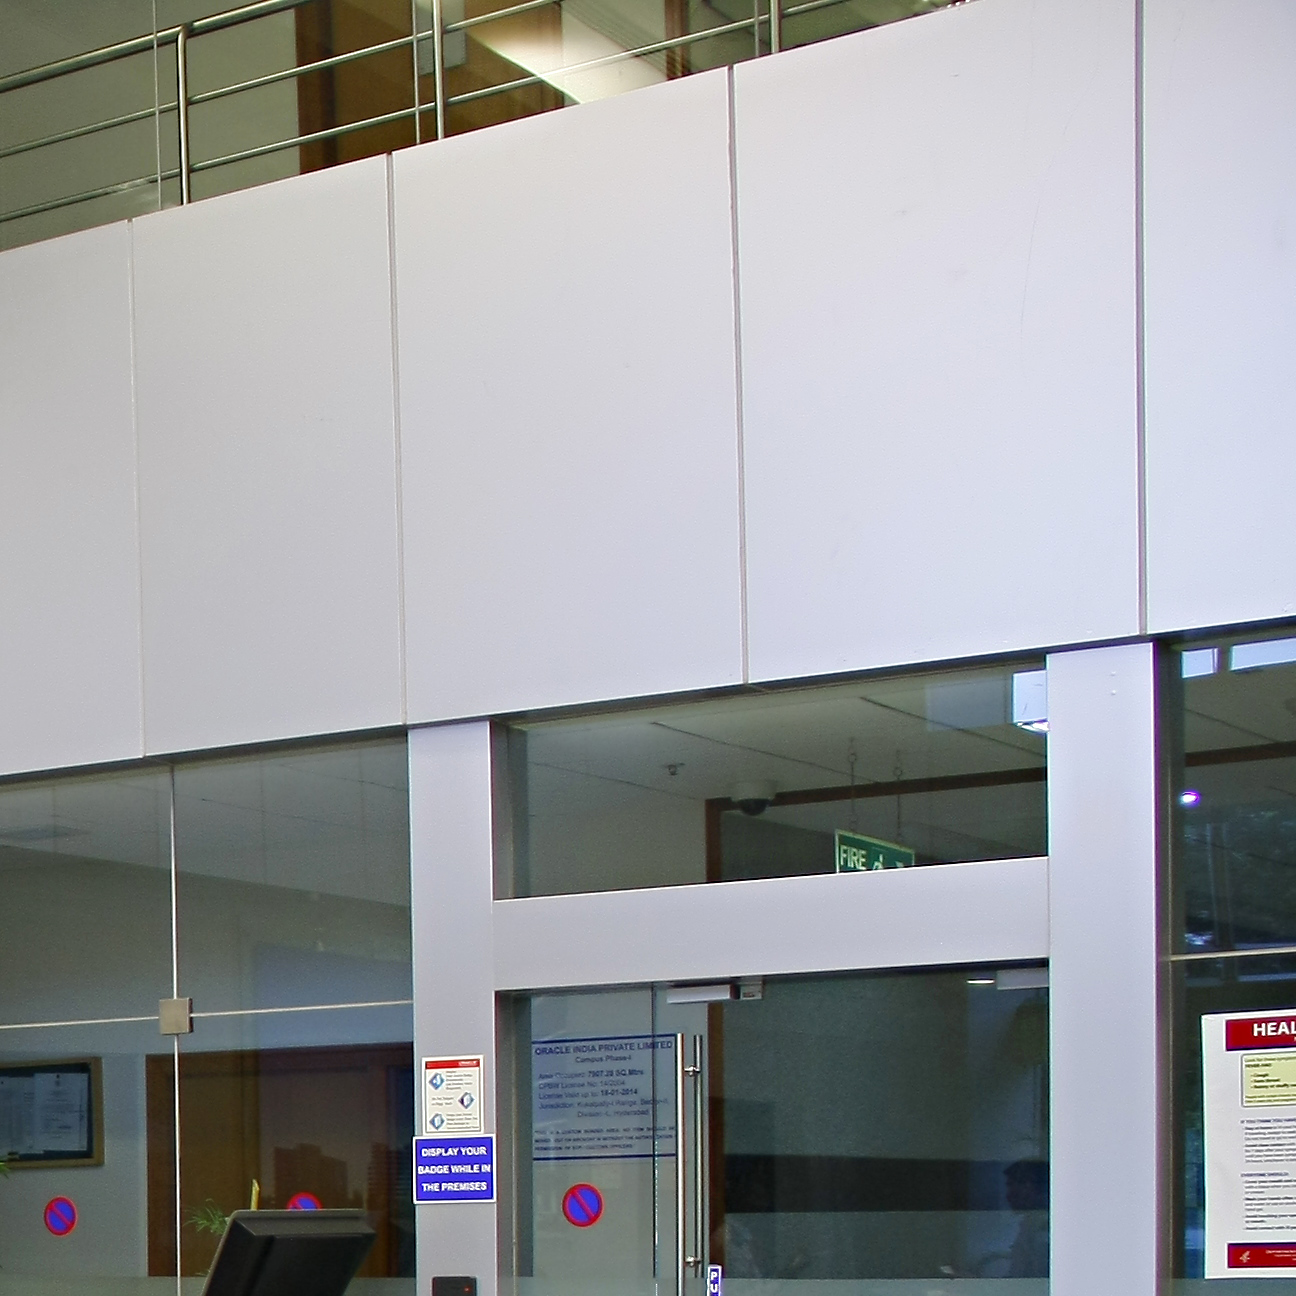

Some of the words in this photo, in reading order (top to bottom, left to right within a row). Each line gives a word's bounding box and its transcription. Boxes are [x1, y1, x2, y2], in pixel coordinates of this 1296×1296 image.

[840, 844, 867, 870] FIRE
[1253, 1021, 1296, 1036] HEAL
[535, 1046, 570, 1055] ORACLE
[573, 1044, 597, 1053] INDIA
[598, 1043, 635, 1052] PRIVATE
[421, 1147, 459, 1157] DISPLAY
[460, 1146, 488, 1156] YOUR
[417, 1165, 450, 1175] BADGE
[450, 1164, 480, 1173] WHILE
[481, 1164, 491, 1173] IN
[421, 1183, 440, 1192] THE
[441, 1181, 487, 1191] PREMISES
